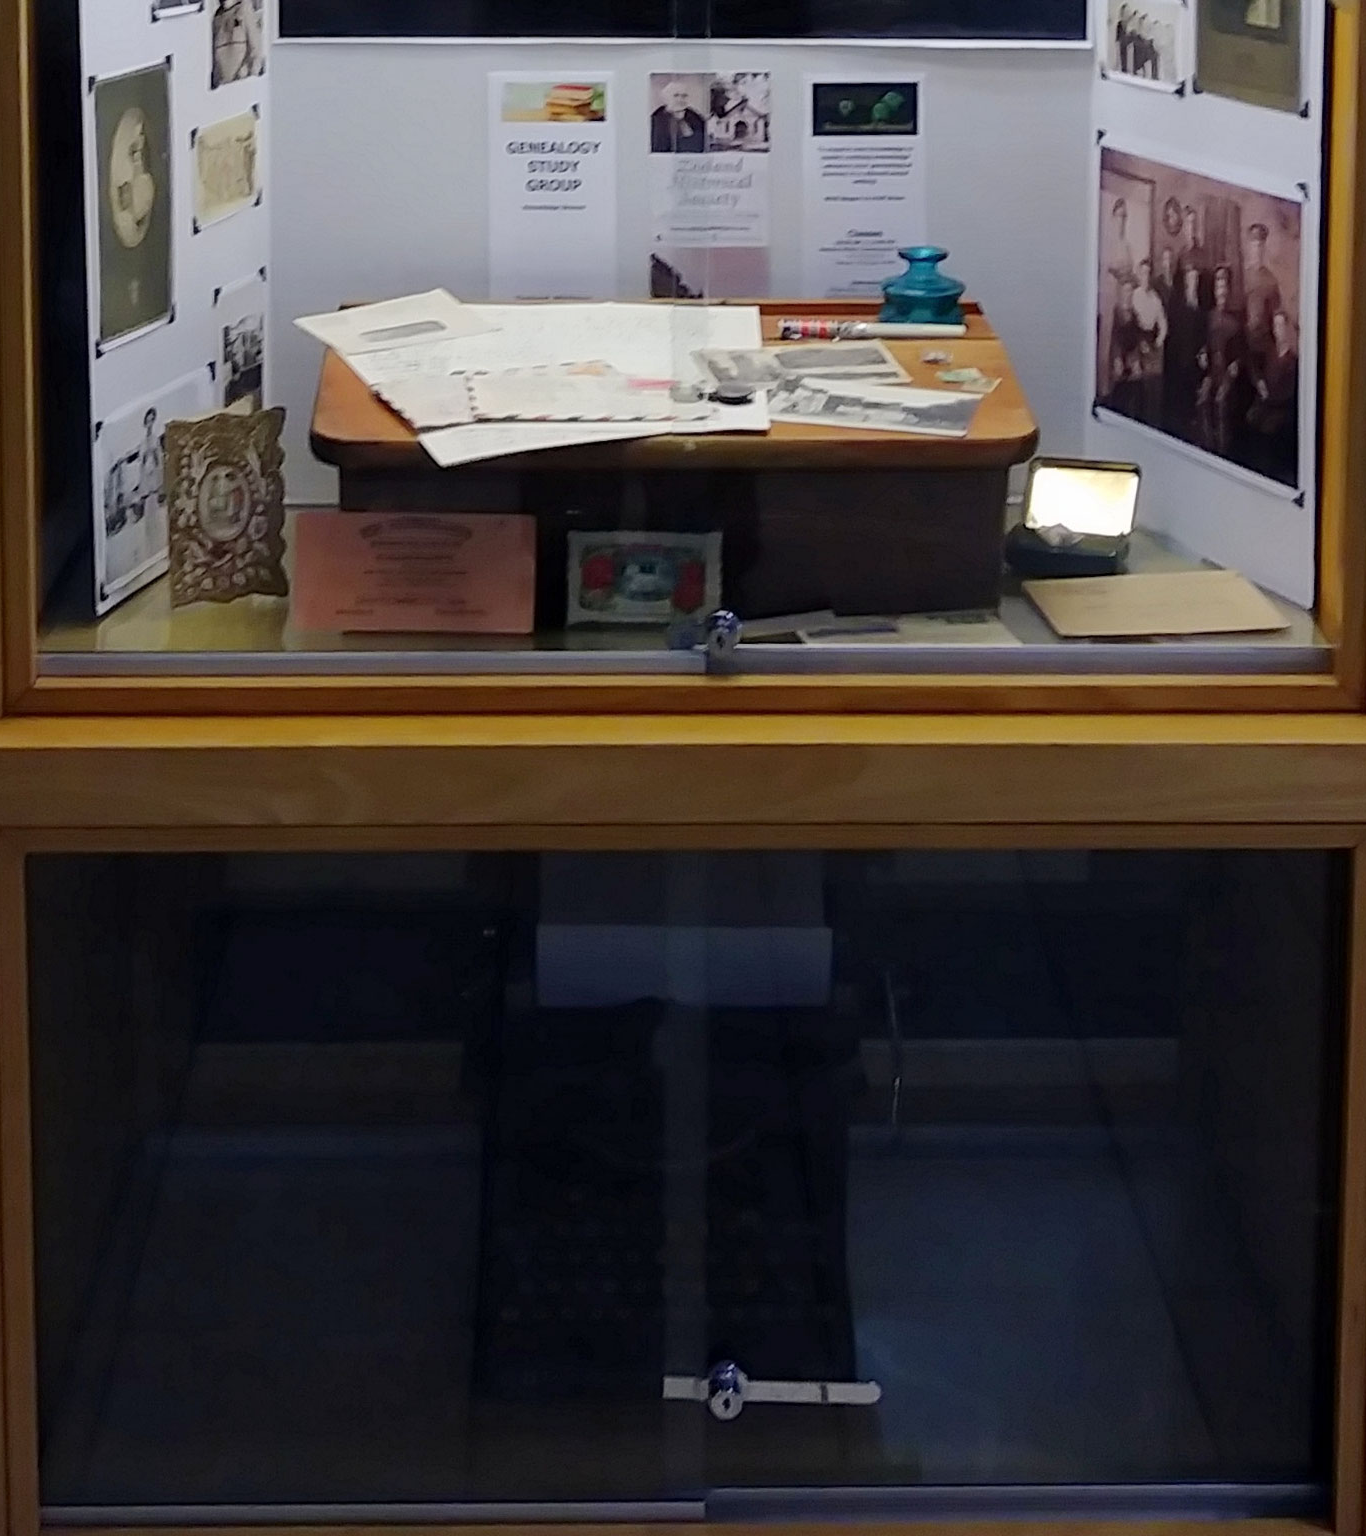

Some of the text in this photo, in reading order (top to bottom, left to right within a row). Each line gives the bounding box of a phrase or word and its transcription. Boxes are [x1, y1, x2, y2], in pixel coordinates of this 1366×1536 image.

[505, 141, 602, 155] GENEALOGY
[527, 159, 581, 174] STUDY
[524, 178, 583, 193] GROUP
